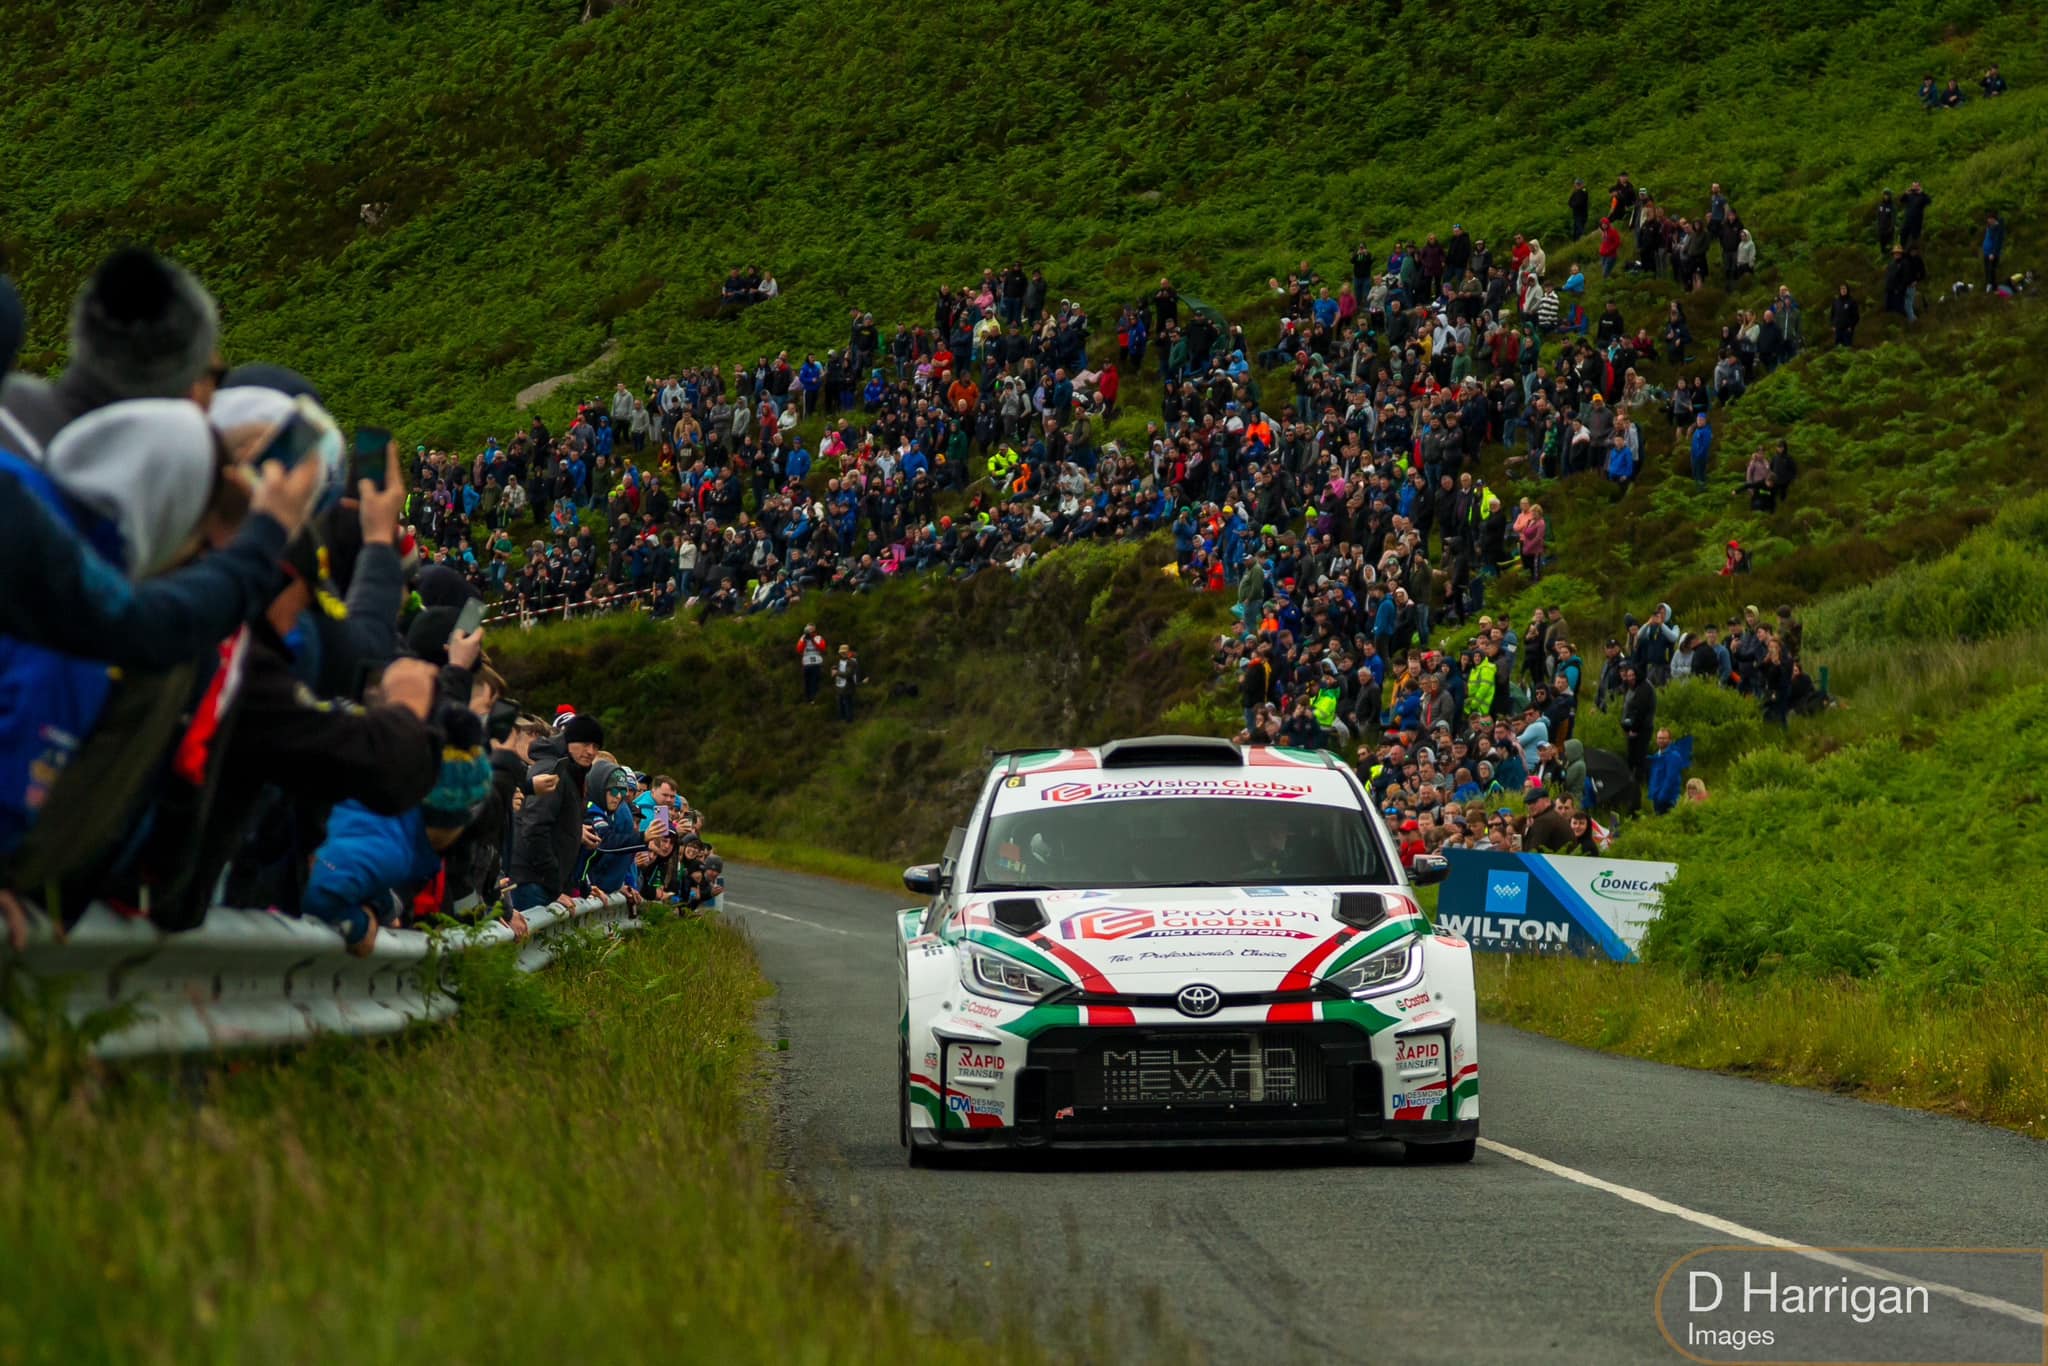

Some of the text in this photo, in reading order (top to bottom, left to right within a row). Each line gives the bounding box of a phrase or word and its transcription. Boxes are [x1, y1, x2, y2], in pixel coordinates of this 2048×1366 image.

[1098, 779, 1313, 793] ProVision Global
[1601, 878, 1657, 892] DONEGA
[1162, 908, 1320, 922] ProVision
[1163, 917, 1283, 928] Global
[1439, 913, 1569, 943] WILTON
[1150, 928, 1301, 938] MOTORSPORT
[1472, 936, 1563, 951] CYCLING
[968, 1001, 1002, 1018] Castrol
[1395, 1039, 1439, 1061] RAPID
[958, 1045, 1005, 1070] RAPID
[958, 1068, 1004, 1080] TRANSLIFT
